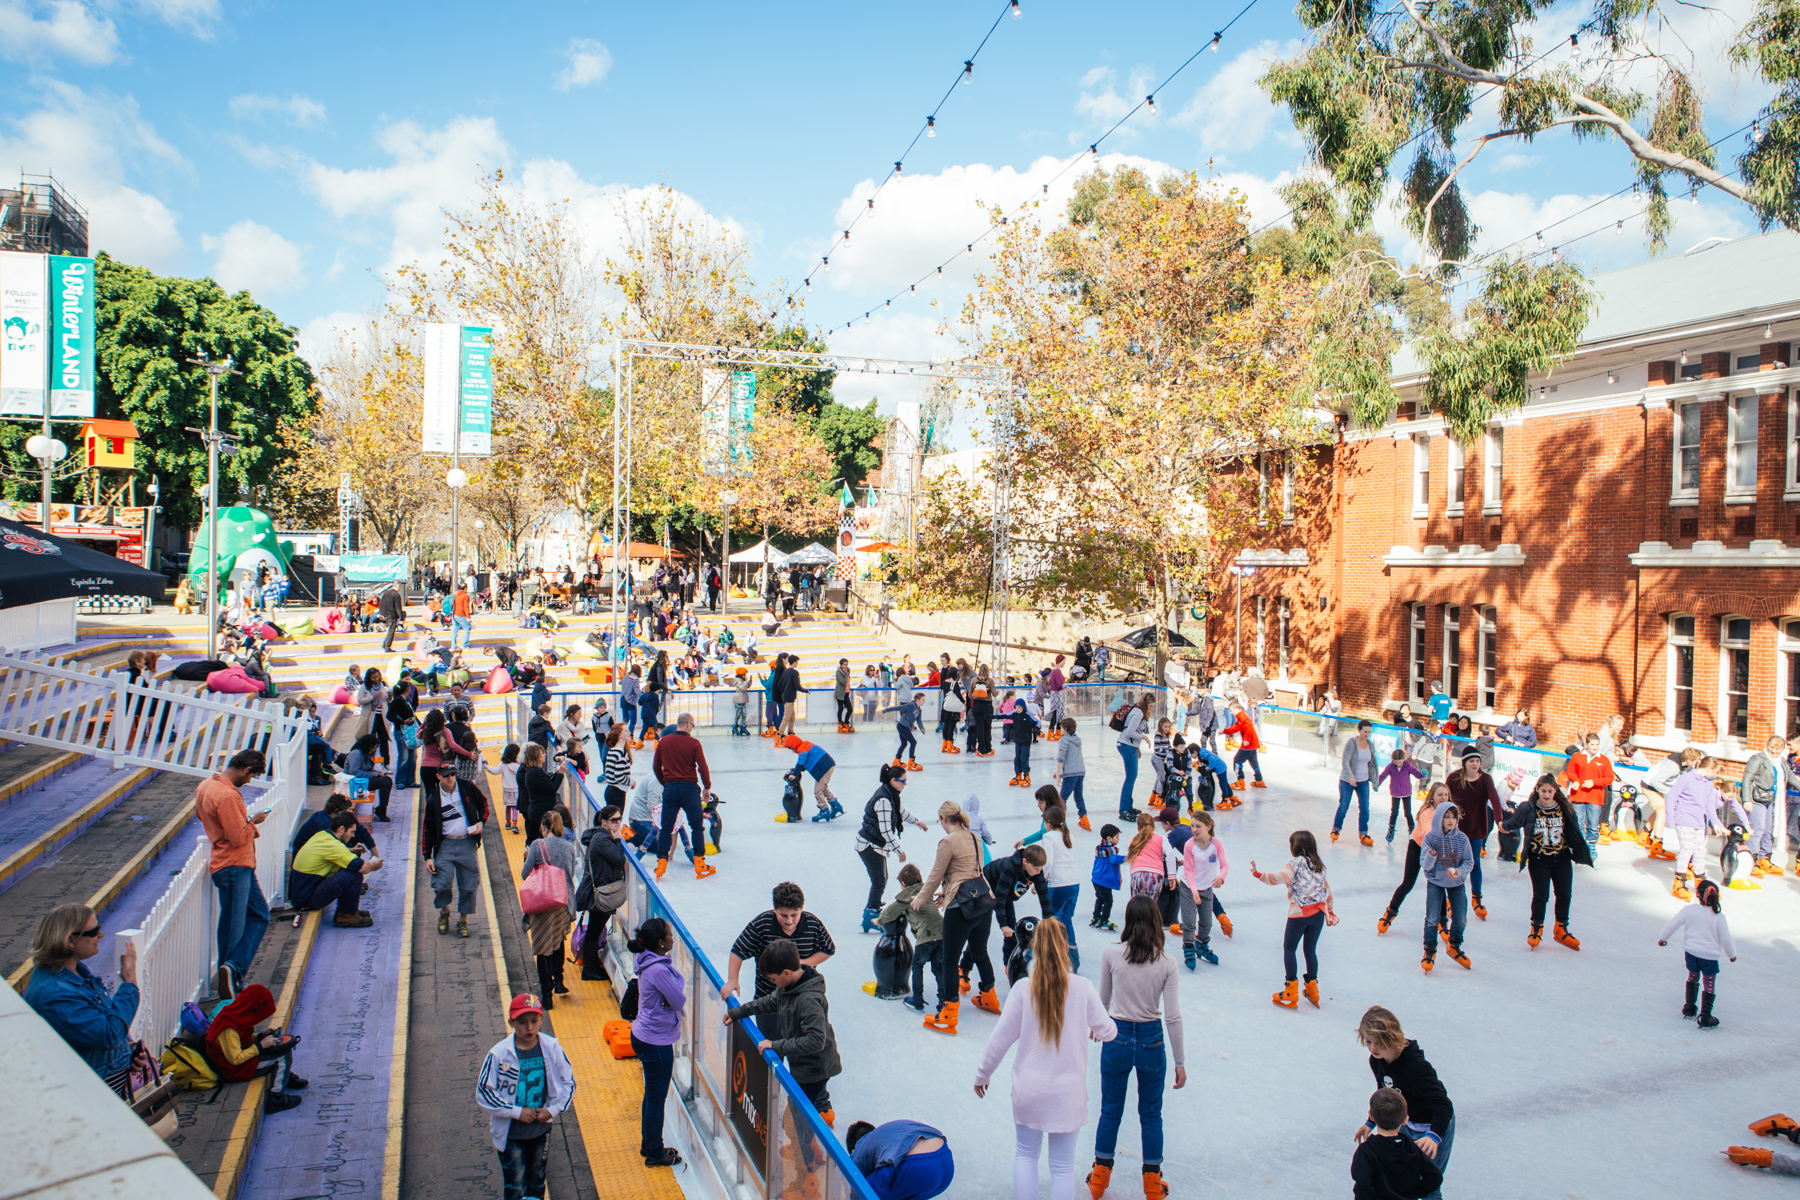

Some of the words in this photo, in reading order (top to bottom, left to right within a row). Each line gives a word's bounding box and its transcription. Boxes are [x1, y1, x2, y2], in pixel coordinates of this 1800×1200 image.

[4, 289, 39, 297] FOLLOW
[61, 262, 87, 388] WinterLAND
[345, 562, 402, 574] WinterLAND
[1533, 827, 1564, 847] 76
[316, 1102, 355, 1127] 1979
